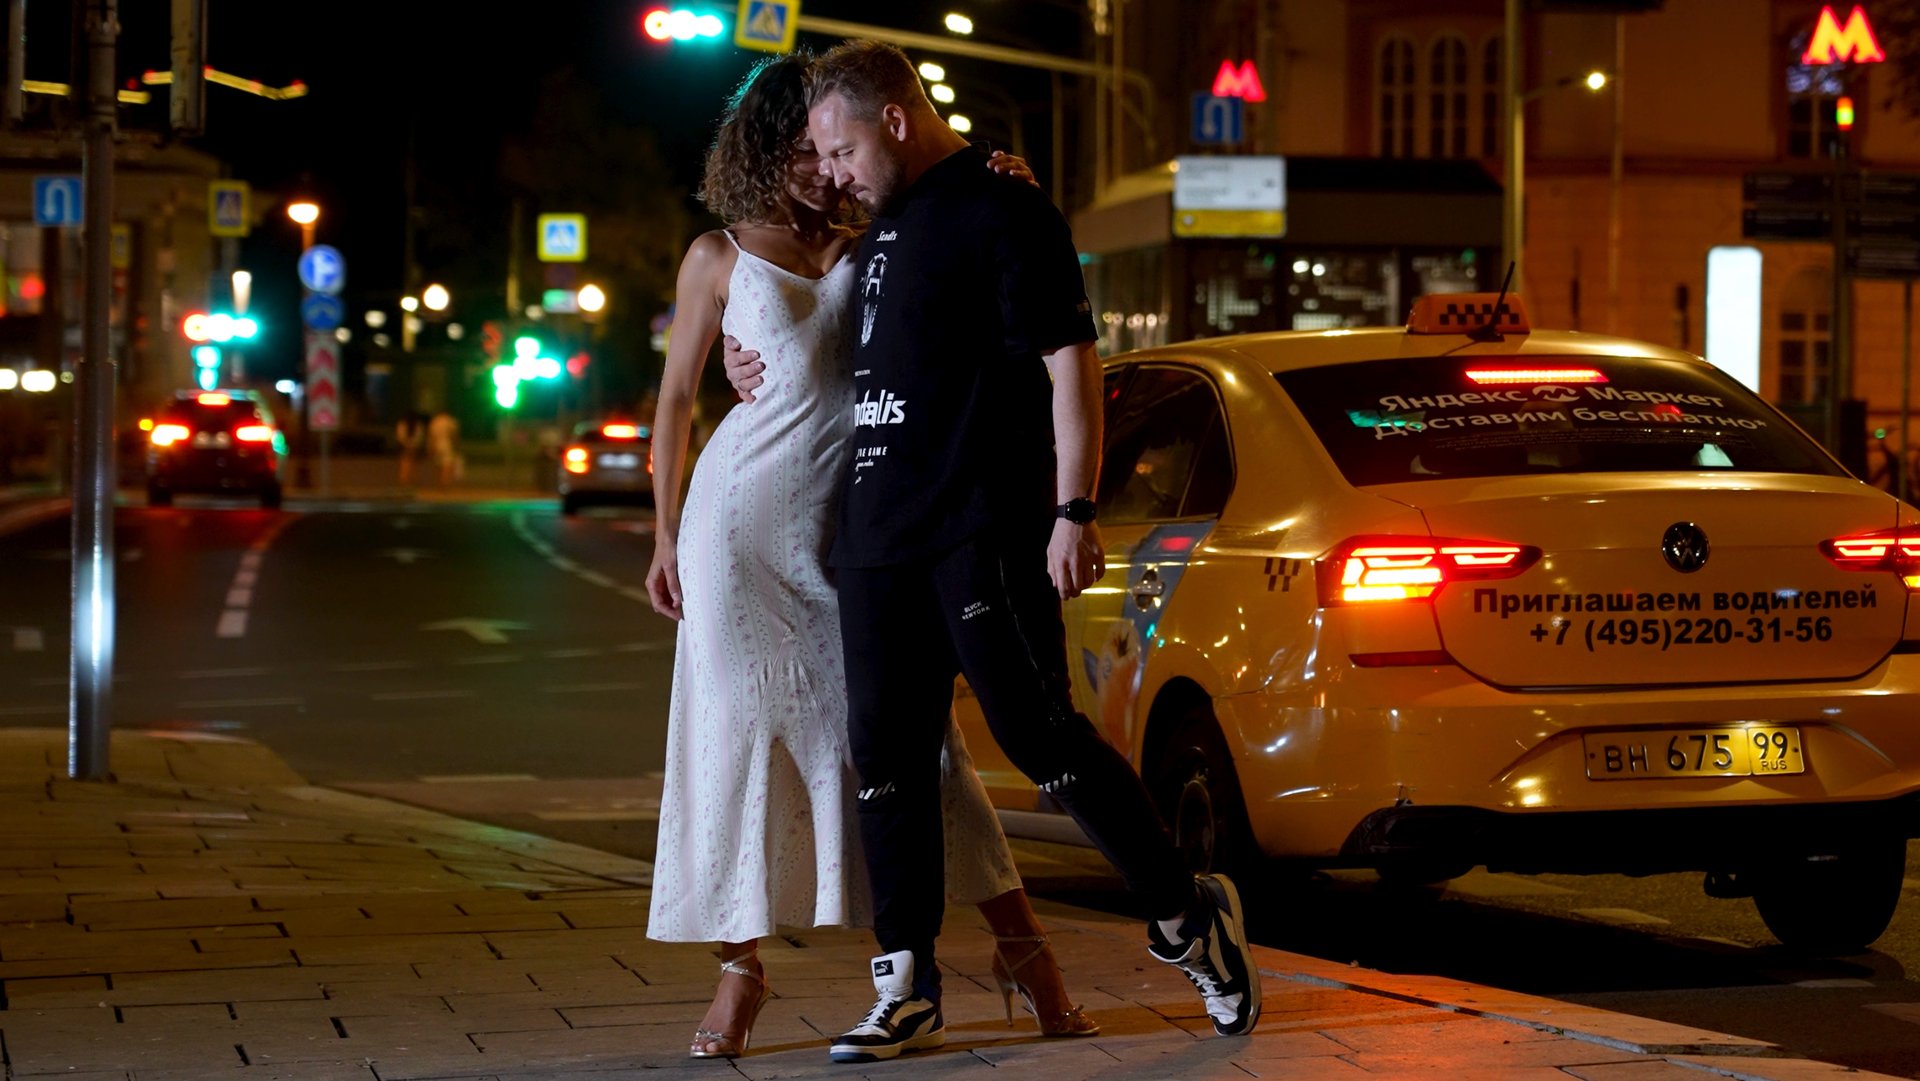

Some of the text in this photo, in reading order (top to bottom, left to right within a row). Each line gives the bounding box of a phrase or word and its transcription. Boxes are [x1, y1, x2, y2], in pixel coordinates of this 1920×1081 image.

[1378, 386, 1725, 412] Яндекс Маркет
[1373, 411, 1567, 441] Доставим
[1474, 583, 1877, 619] Приглашаем водителей
[1530, 616, 1832, 652] +7 (495)220-31-56
[1667, 734, 1733, 771] 675
[1753, 732, 1789, 760] 99
[1760, 759, 1788, 771] RUS
